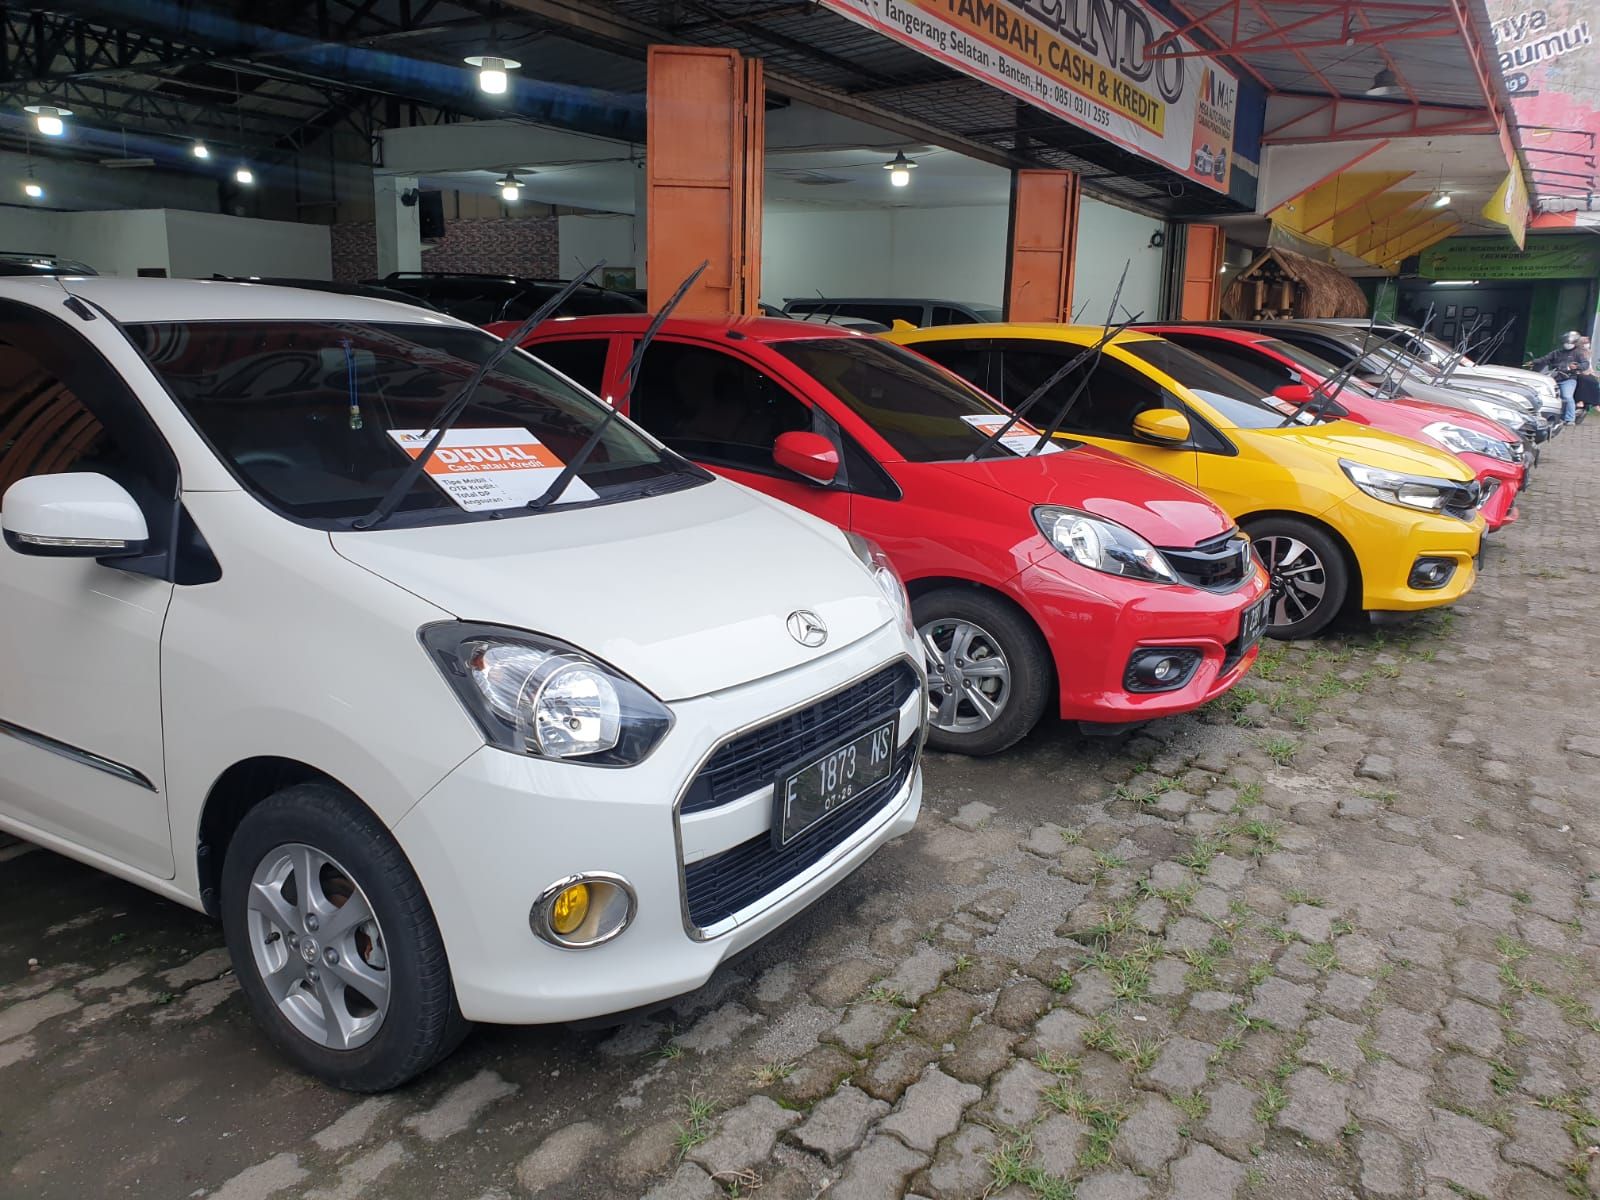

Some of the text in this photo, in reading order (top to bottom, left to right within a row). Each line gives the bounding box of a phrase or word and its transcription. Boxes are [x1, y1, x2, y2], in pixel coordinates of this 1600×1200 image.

[885, 0, 947, 50] Tangerang
[950, 30, 990, 68] Selatan
[998, 55, 1034, 92] Banten,
[1035, 75, 1048, 100] Hp
[1054, 86, 1072, 108] 0851
[1074, 97, 1091, 118] 0311
[1093, 105, 1110, 127] 2555
[1048, 40, 1094, 91] CASH
[1097, 70, 1109, 98] &
[1113, 78, 1159, 126] KREDIT
[1217, 80, 1234, 112] MAF
[434, 446, 537, 465] DIJUAL
[447, 460, 545, 473] Cash atau Kredit
[456, 491, 478, 499] Total
[468, 483, 495, 491] Kredit
[464, 497, 504, 505] Angsuran
[786, 726, 890, 819] F 1873 NS
